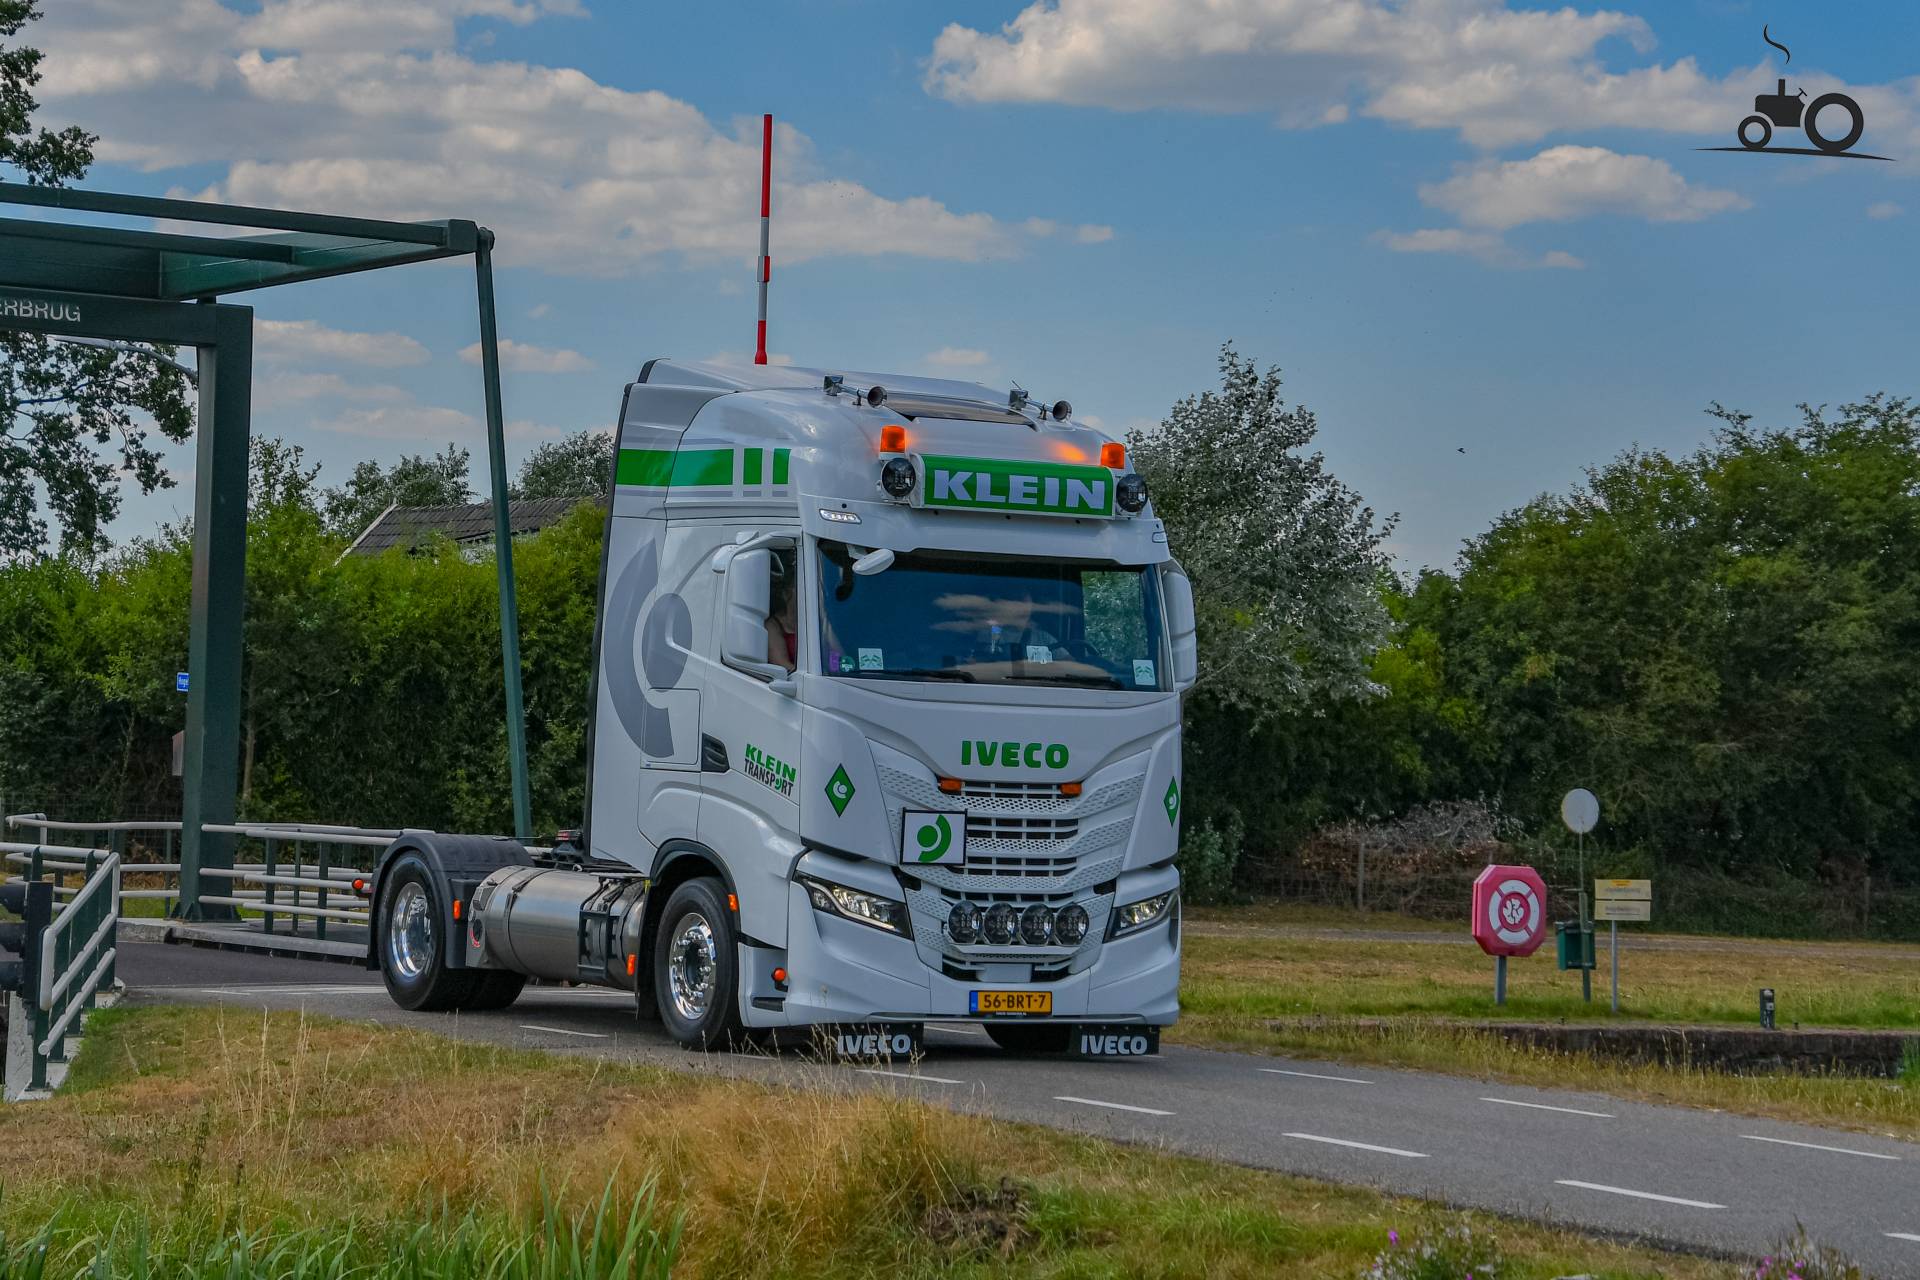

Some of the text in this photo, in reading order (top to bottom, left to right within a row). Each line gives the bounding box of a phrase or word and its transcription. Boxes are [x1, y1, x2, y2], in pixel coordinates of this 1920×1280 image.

[0, 298, 81, 322] RBRUG
[933, 470, 1106, 510] KLEIN
[745, 743, 797, 782] KLEIN
[961, 740, 1070, 769] IVECO
[744, 758, 794, 797] TRANSPORT
[983, 994, 1047, 1009] 56-BRT-7
[836, 1034, 911, 1055] IVECO
[1080, 1034, 1148, 1055] IVECO
